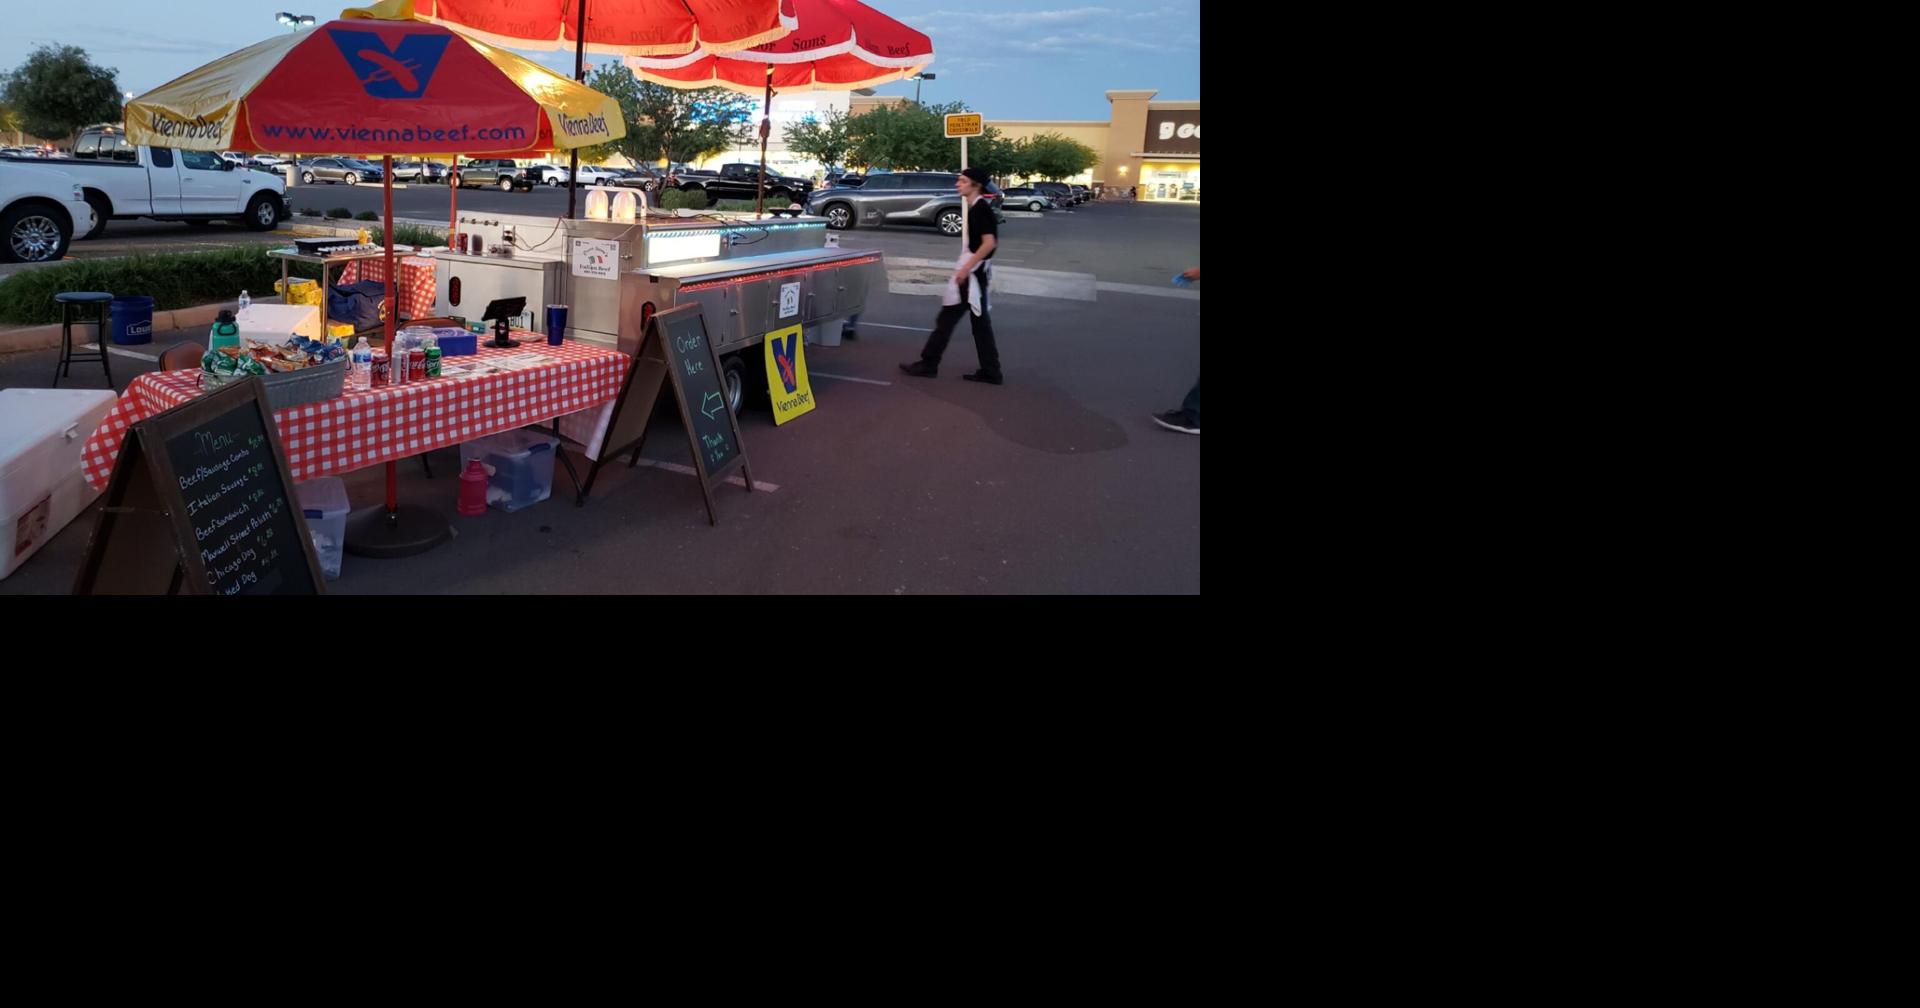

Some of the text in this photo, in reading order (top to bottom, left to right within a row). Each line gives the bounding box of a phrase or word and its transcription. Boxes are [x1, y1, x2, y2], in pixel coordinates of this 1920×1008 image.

[263, 124, 526, 142] www.viennabeef.com
[676, 332, 701, 353] Order
[684, 358, 704, 376] Here
[207, 557, 242, 585] Chicago
[241, 571, 257, 583] Dog
